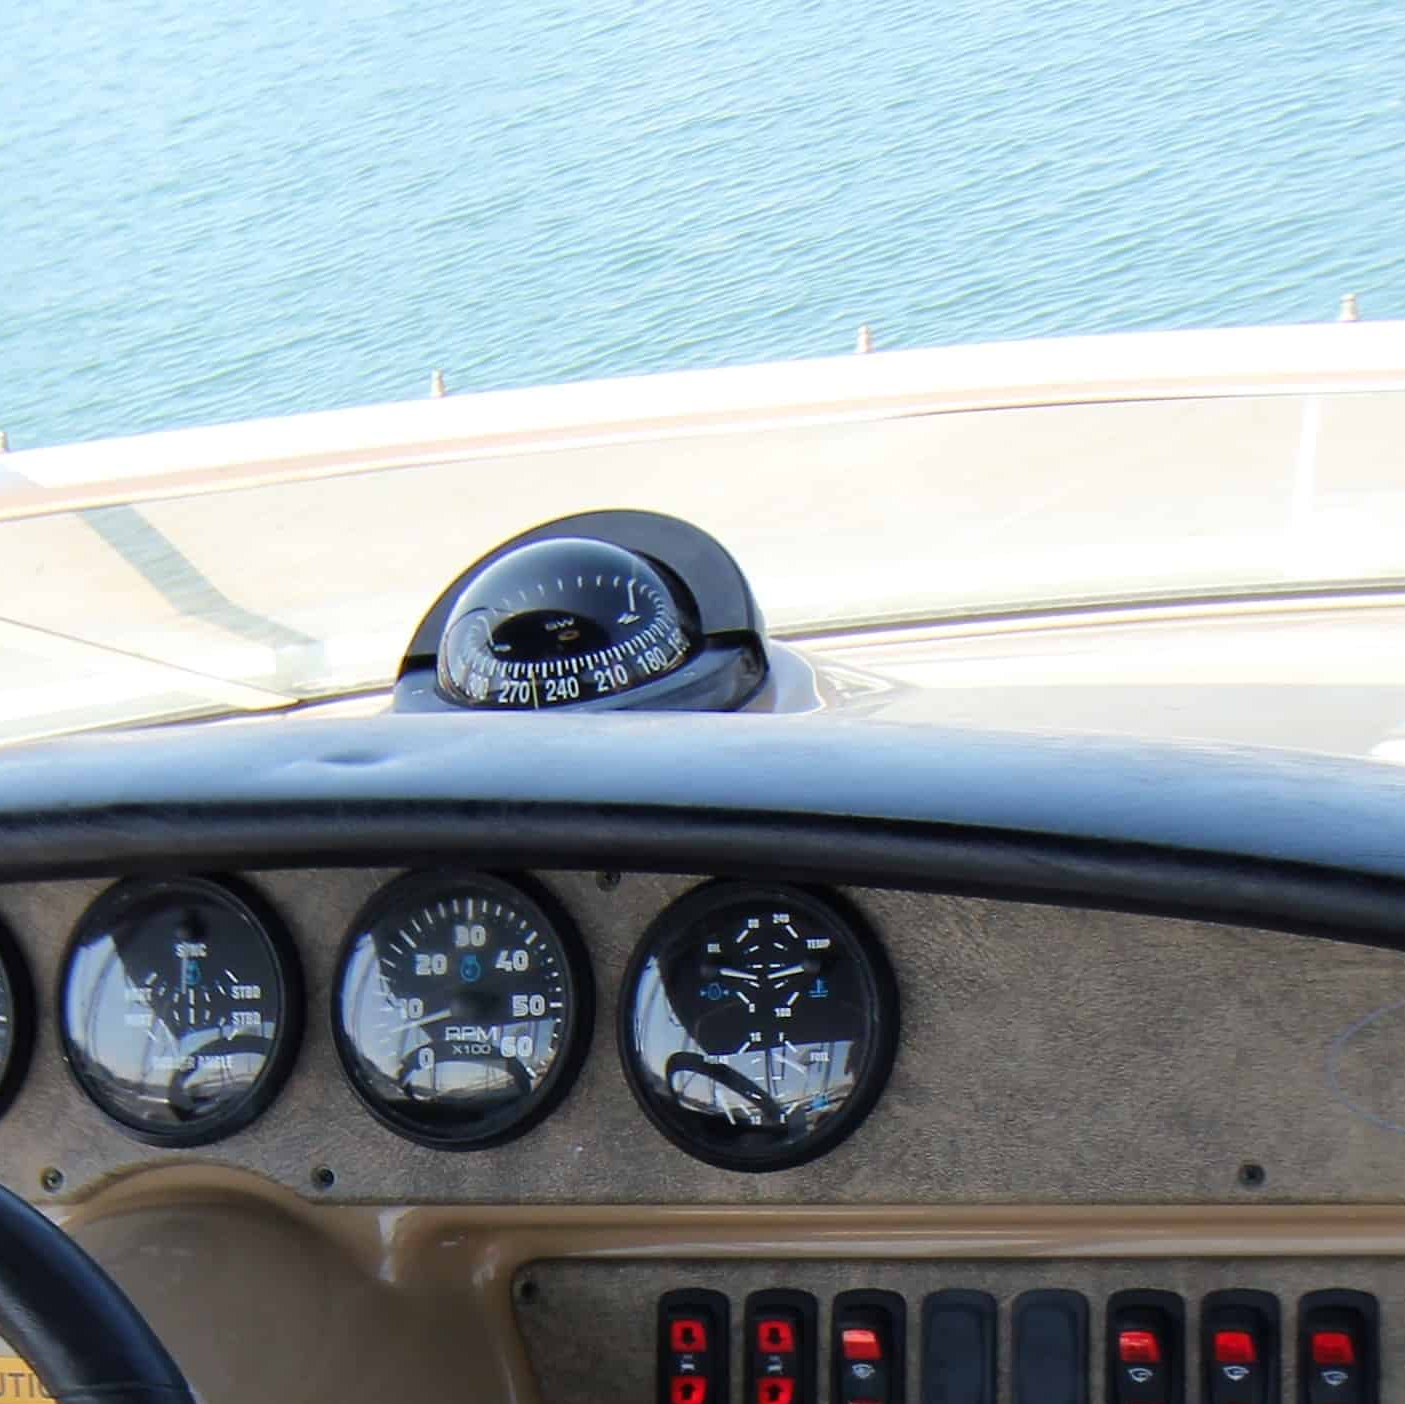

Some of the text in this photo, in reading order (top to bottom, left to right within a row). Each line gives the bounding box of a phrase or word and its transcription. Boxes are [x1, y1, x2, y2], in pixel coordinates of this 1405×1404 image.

[497, 679, 531, 703] 270
[545, 676, 580, 701] 240
[594, 666, 628, 692] 210
[636, 646, 669, 675] 180
[453, 924, 486, 948] 30
[414, 953, 447, 976] 20
[495, 949, 529, 972] 40
[512, 994, 545, 1017] 50
[445, 1026, 500, 1042] RPM
[418, 1047, 436, 1068] 0
[500, 1036, 534, 1058] 60
